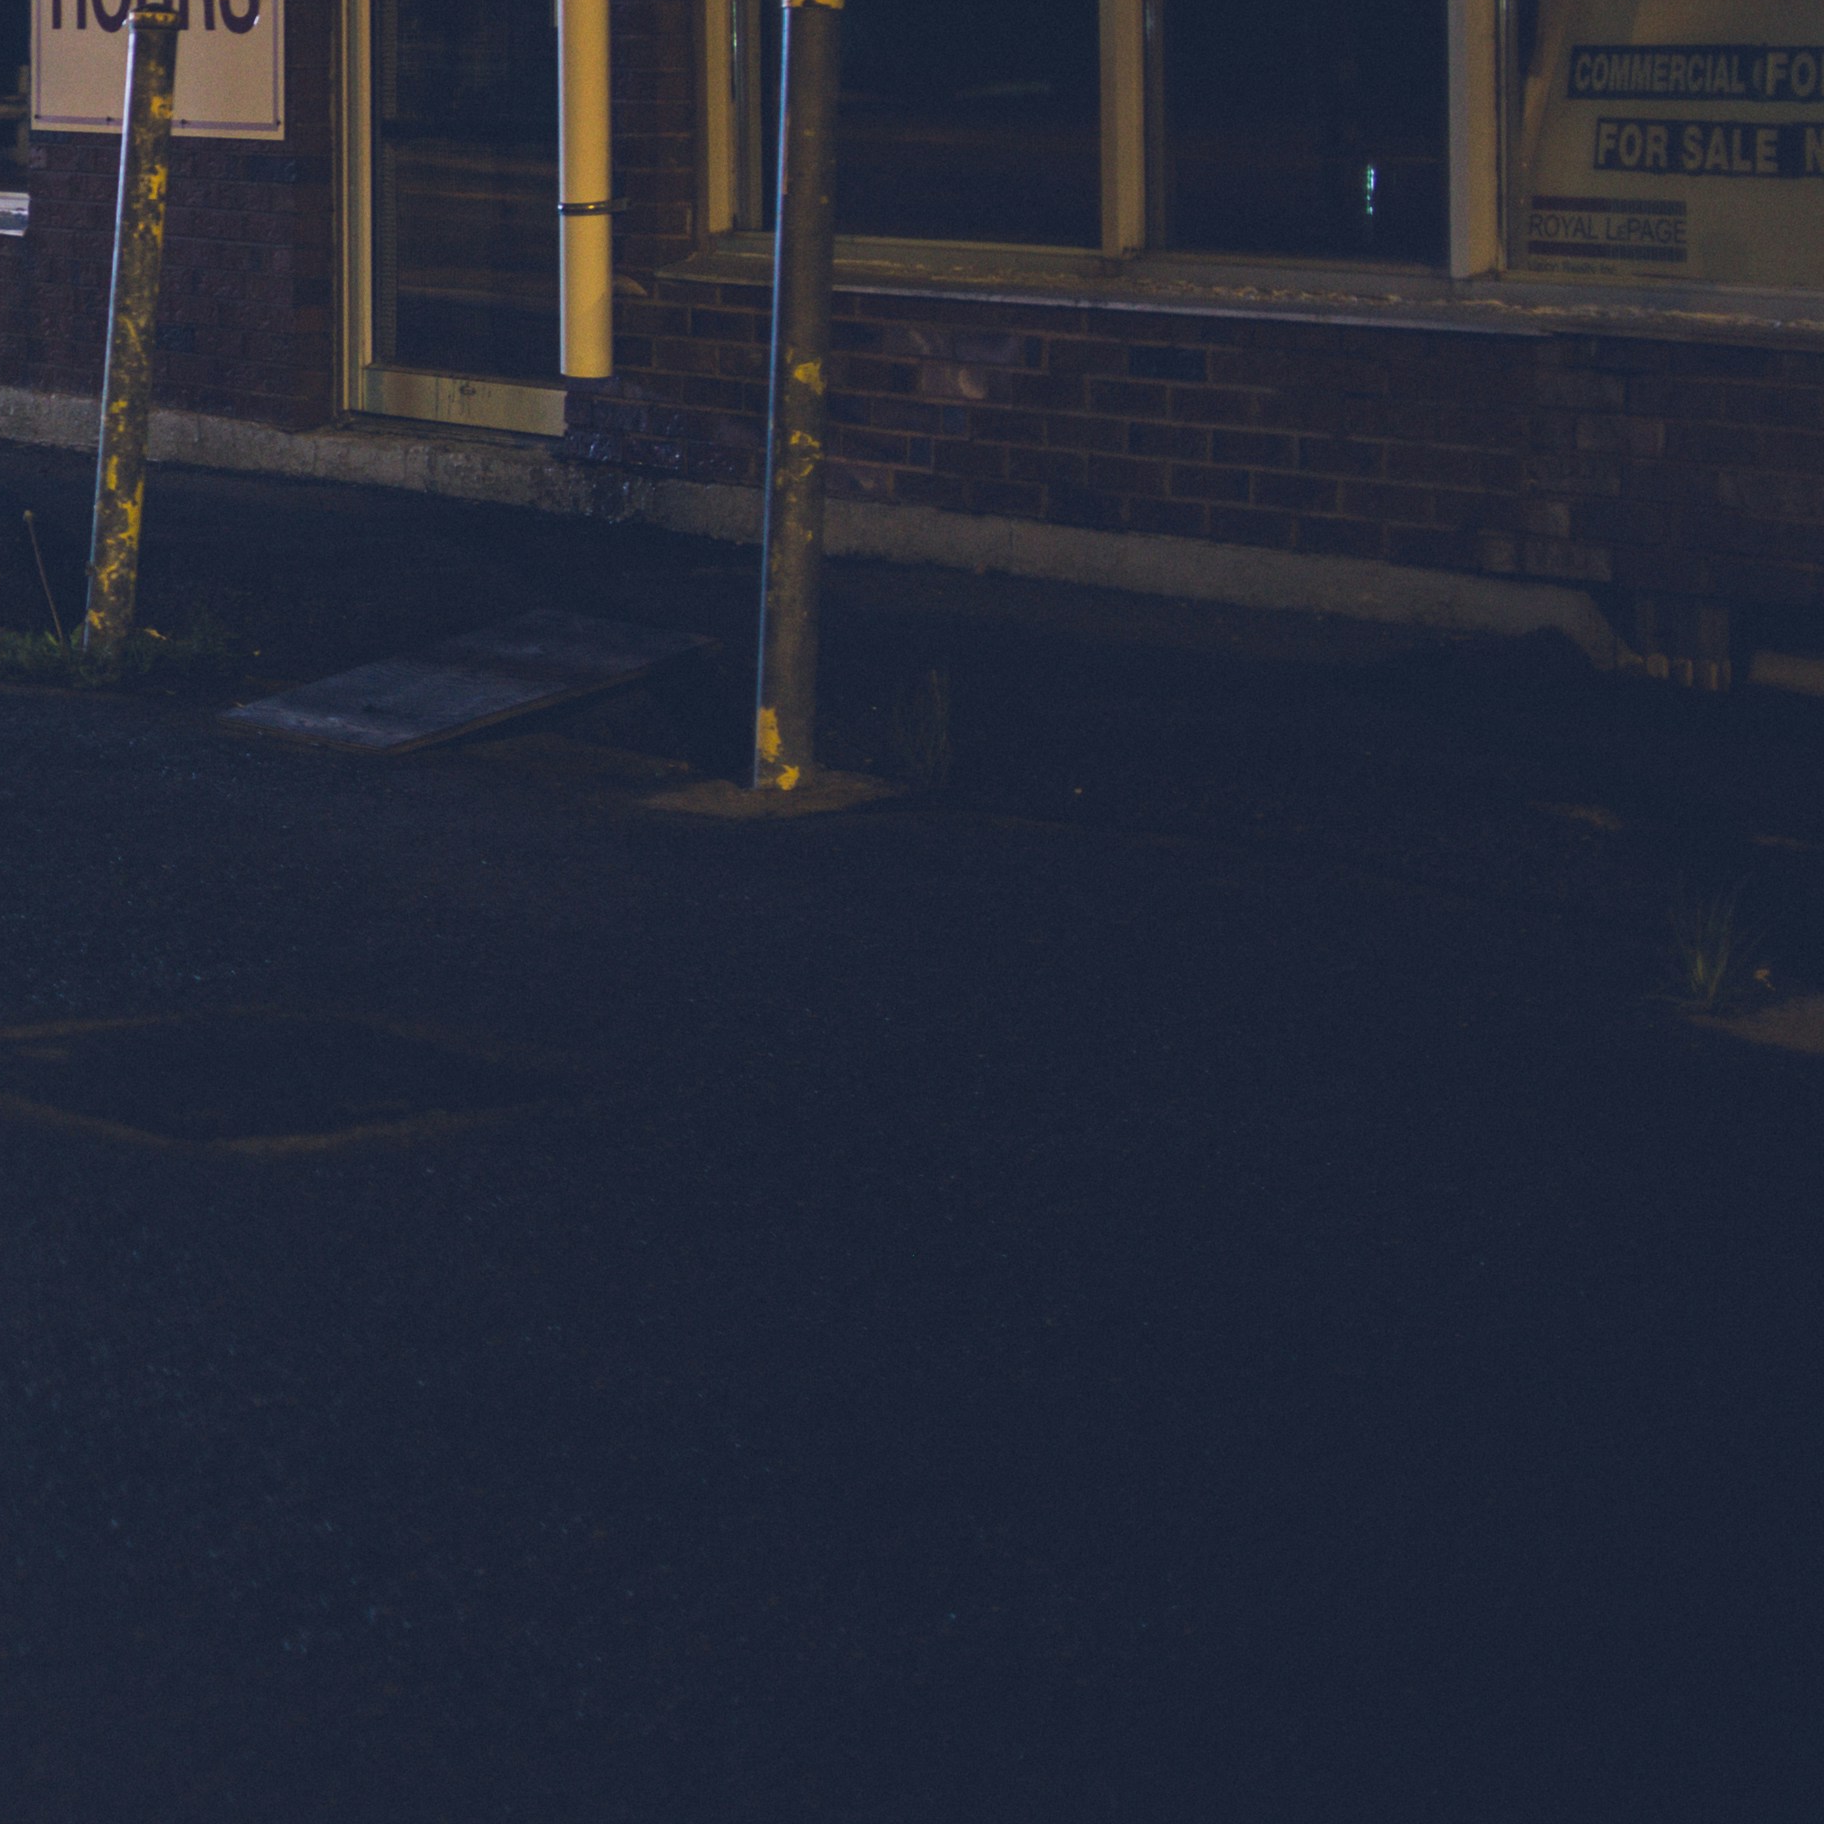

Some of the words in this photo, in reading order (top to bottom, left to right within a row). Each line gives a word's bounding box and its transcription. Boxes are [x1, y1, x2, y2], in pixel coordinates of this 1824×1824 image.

[1574, 52, 1746, 94] COMMERCIAL
[1765, 49, 1824, 98] FO
[1597, 122, 1669, 169] FOR
[1681, 125, 1779, 175] SALE
[1527, 213, 1599, 241] ROYAL
